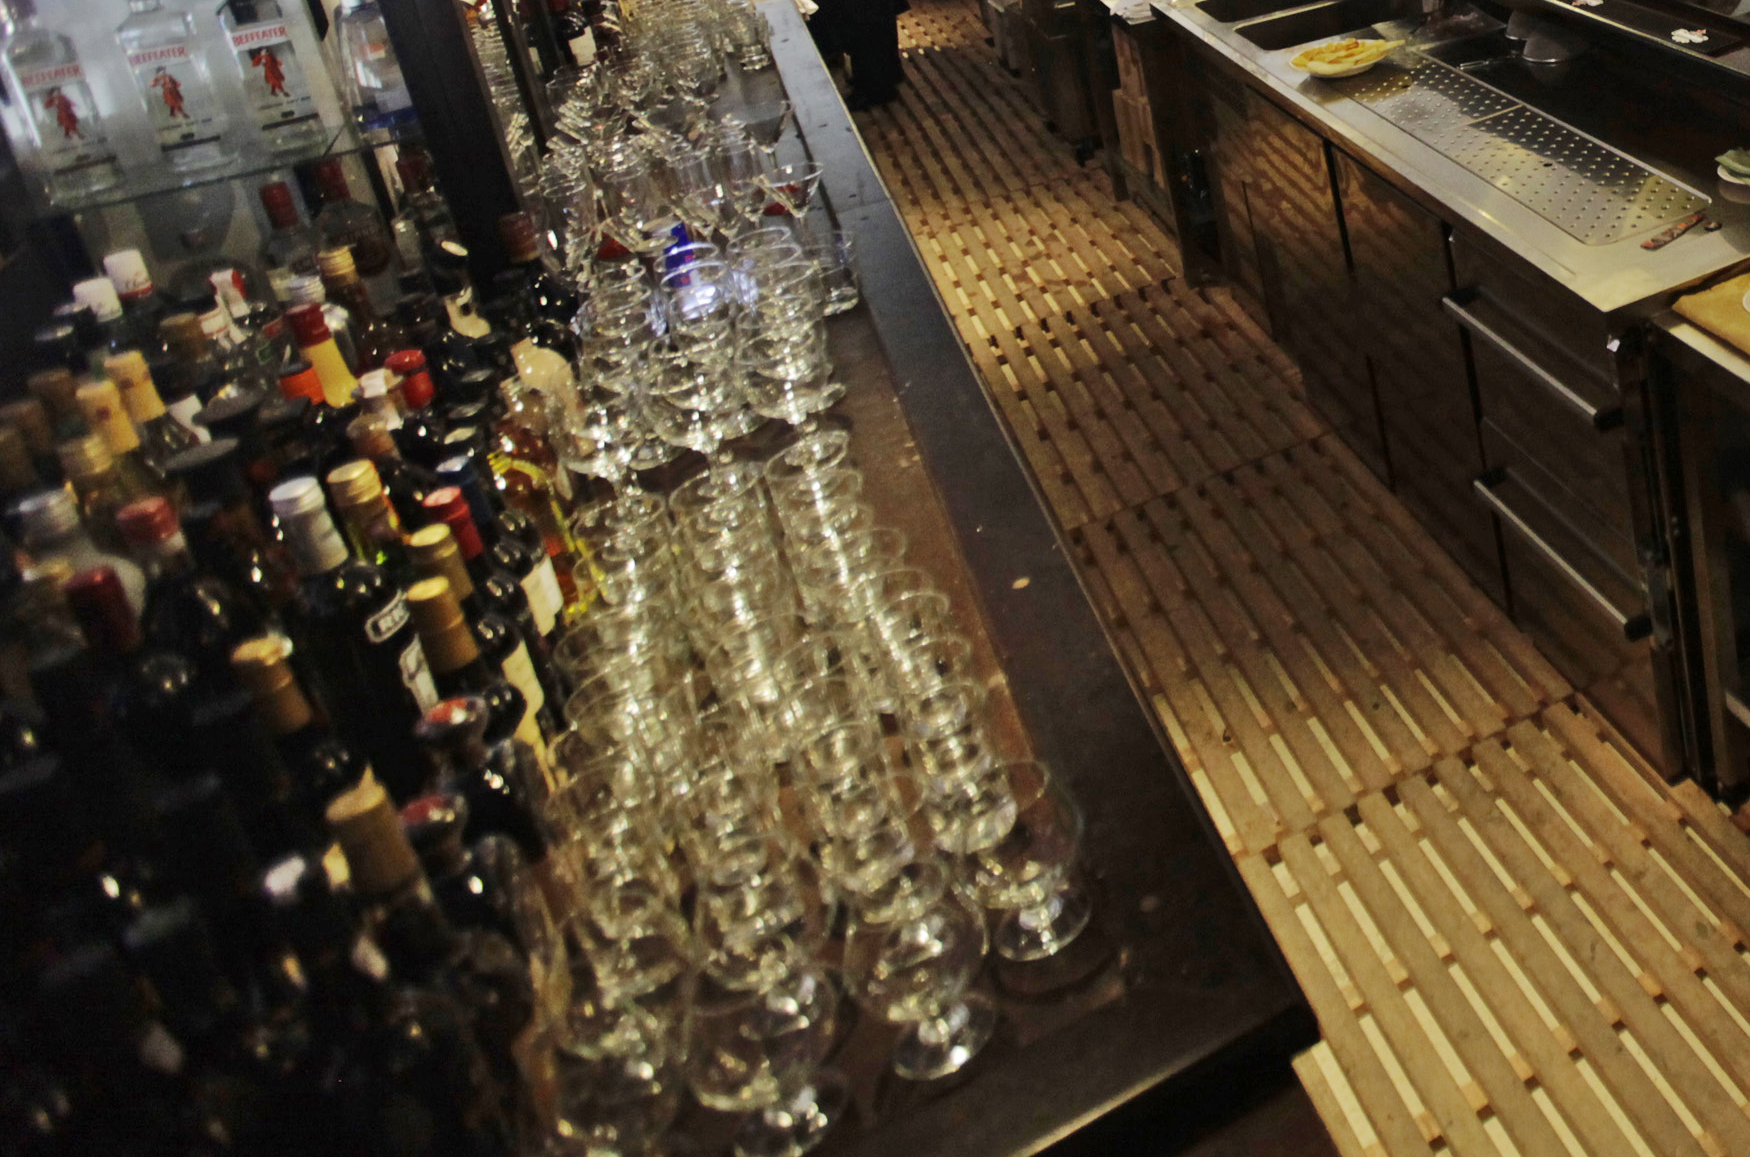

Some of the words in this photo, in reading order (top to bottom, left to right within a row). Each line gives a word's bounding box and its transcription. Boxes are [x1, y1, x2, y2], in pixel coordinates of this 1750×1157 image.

[233, 26, 288, 47] BEEFEATER
[128, 46, 187, 67] BEEFEATER
[20, 64, 82, 89] BEEFEATER
